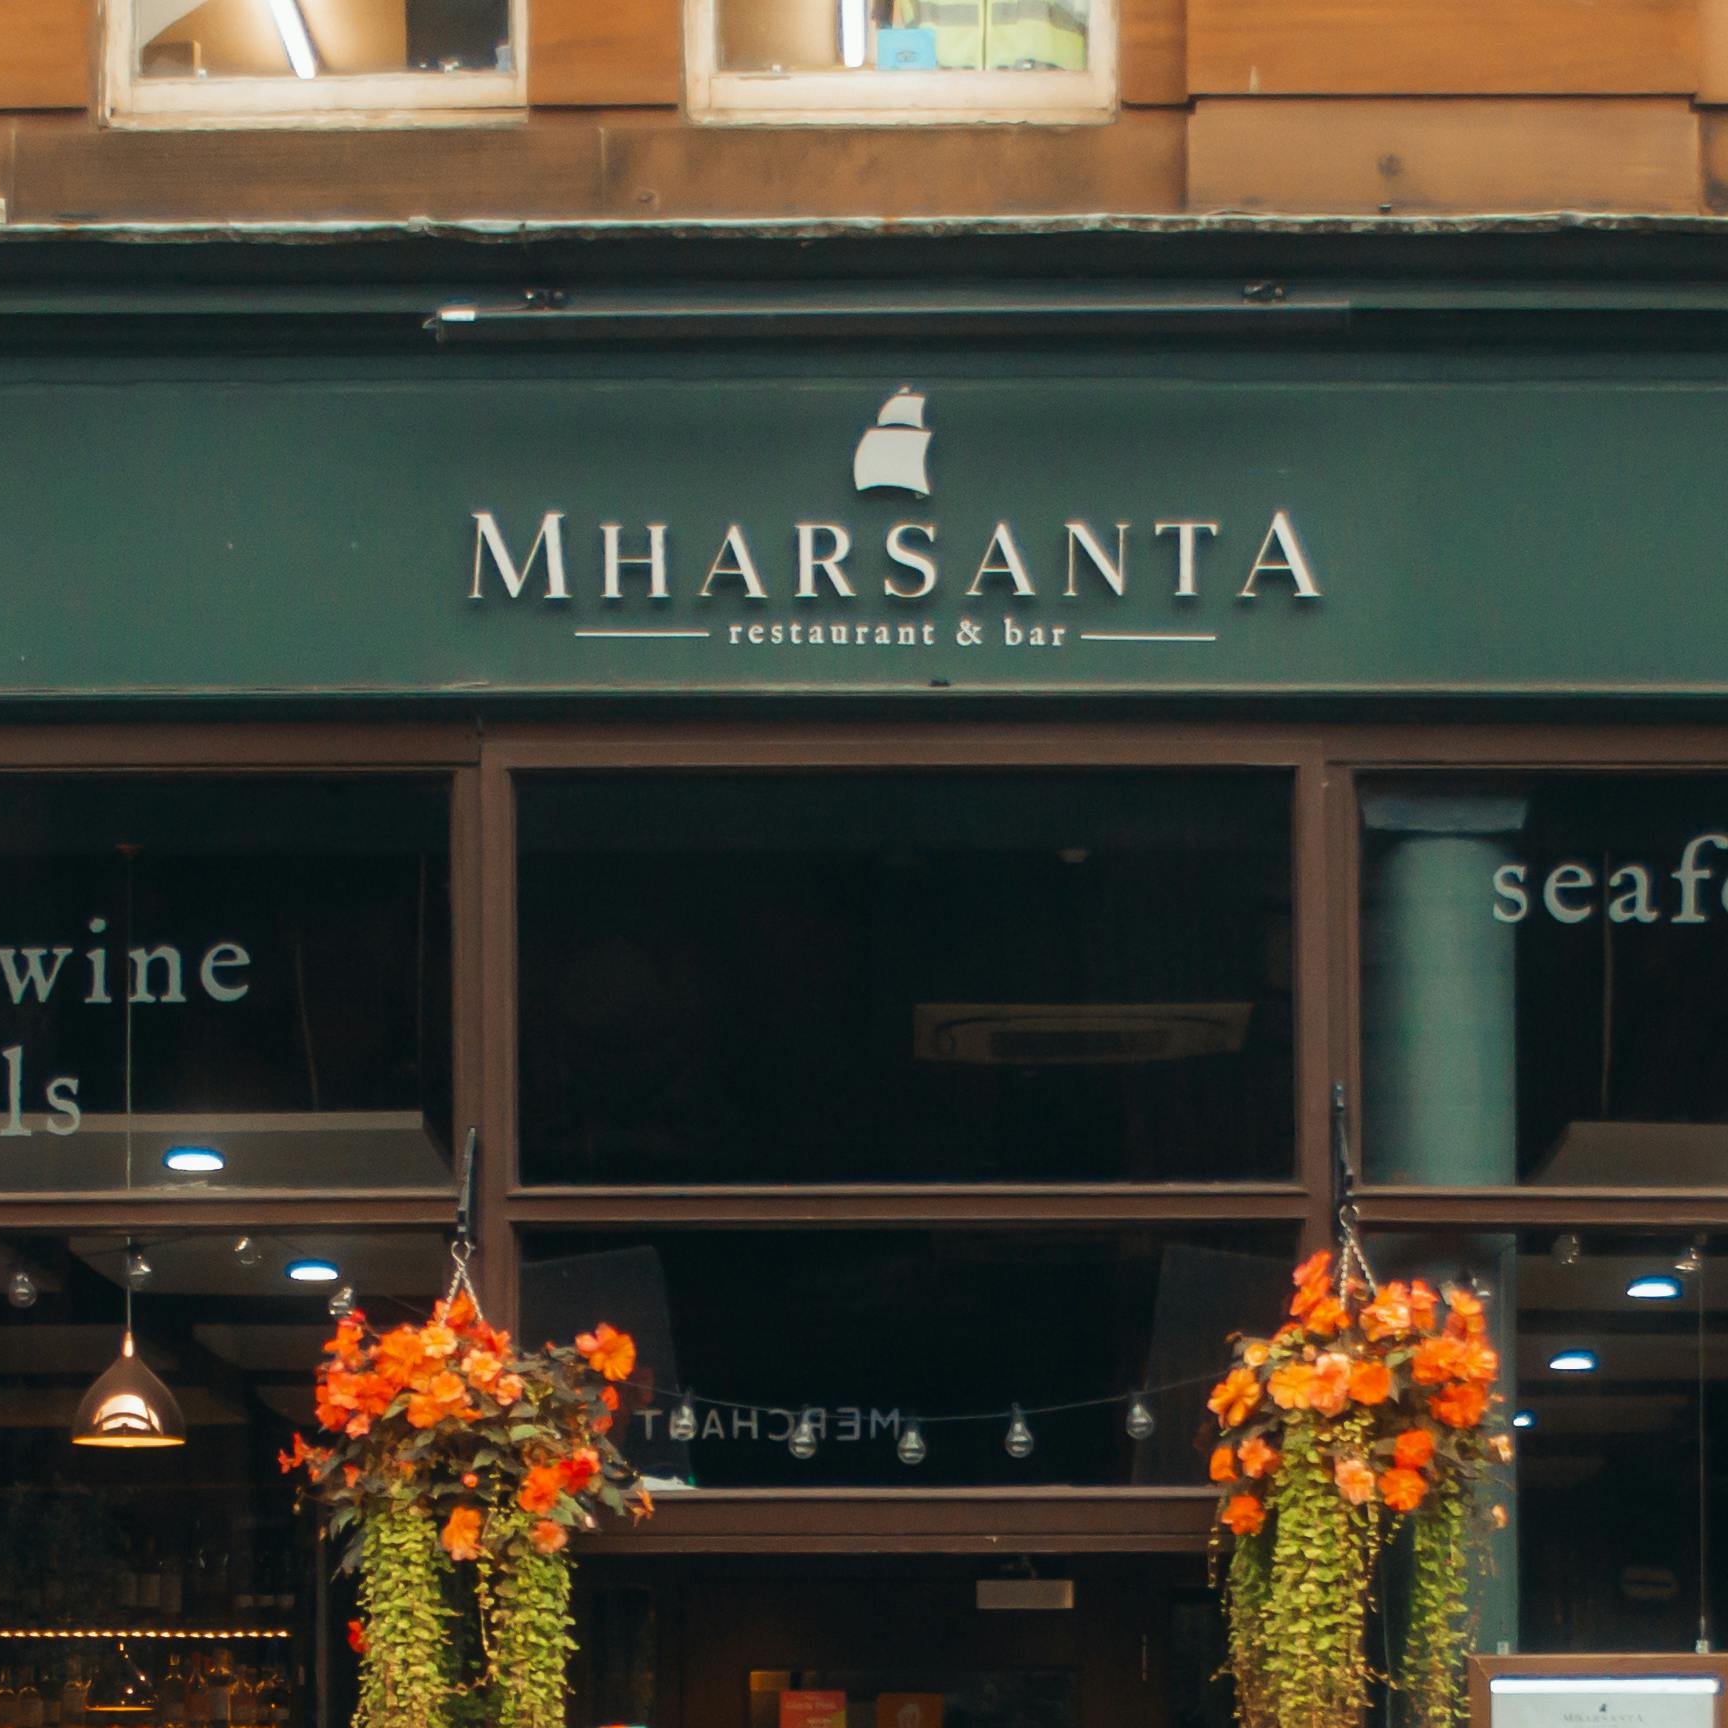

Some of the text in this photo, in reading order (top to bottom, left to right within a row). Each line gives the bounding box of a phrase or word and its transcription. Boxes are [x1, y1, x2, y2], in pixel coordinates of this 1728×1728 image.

[468, 511, 1322, 599] MHARSANTA
[729, 617, 1066, 647] restaurant & bar
